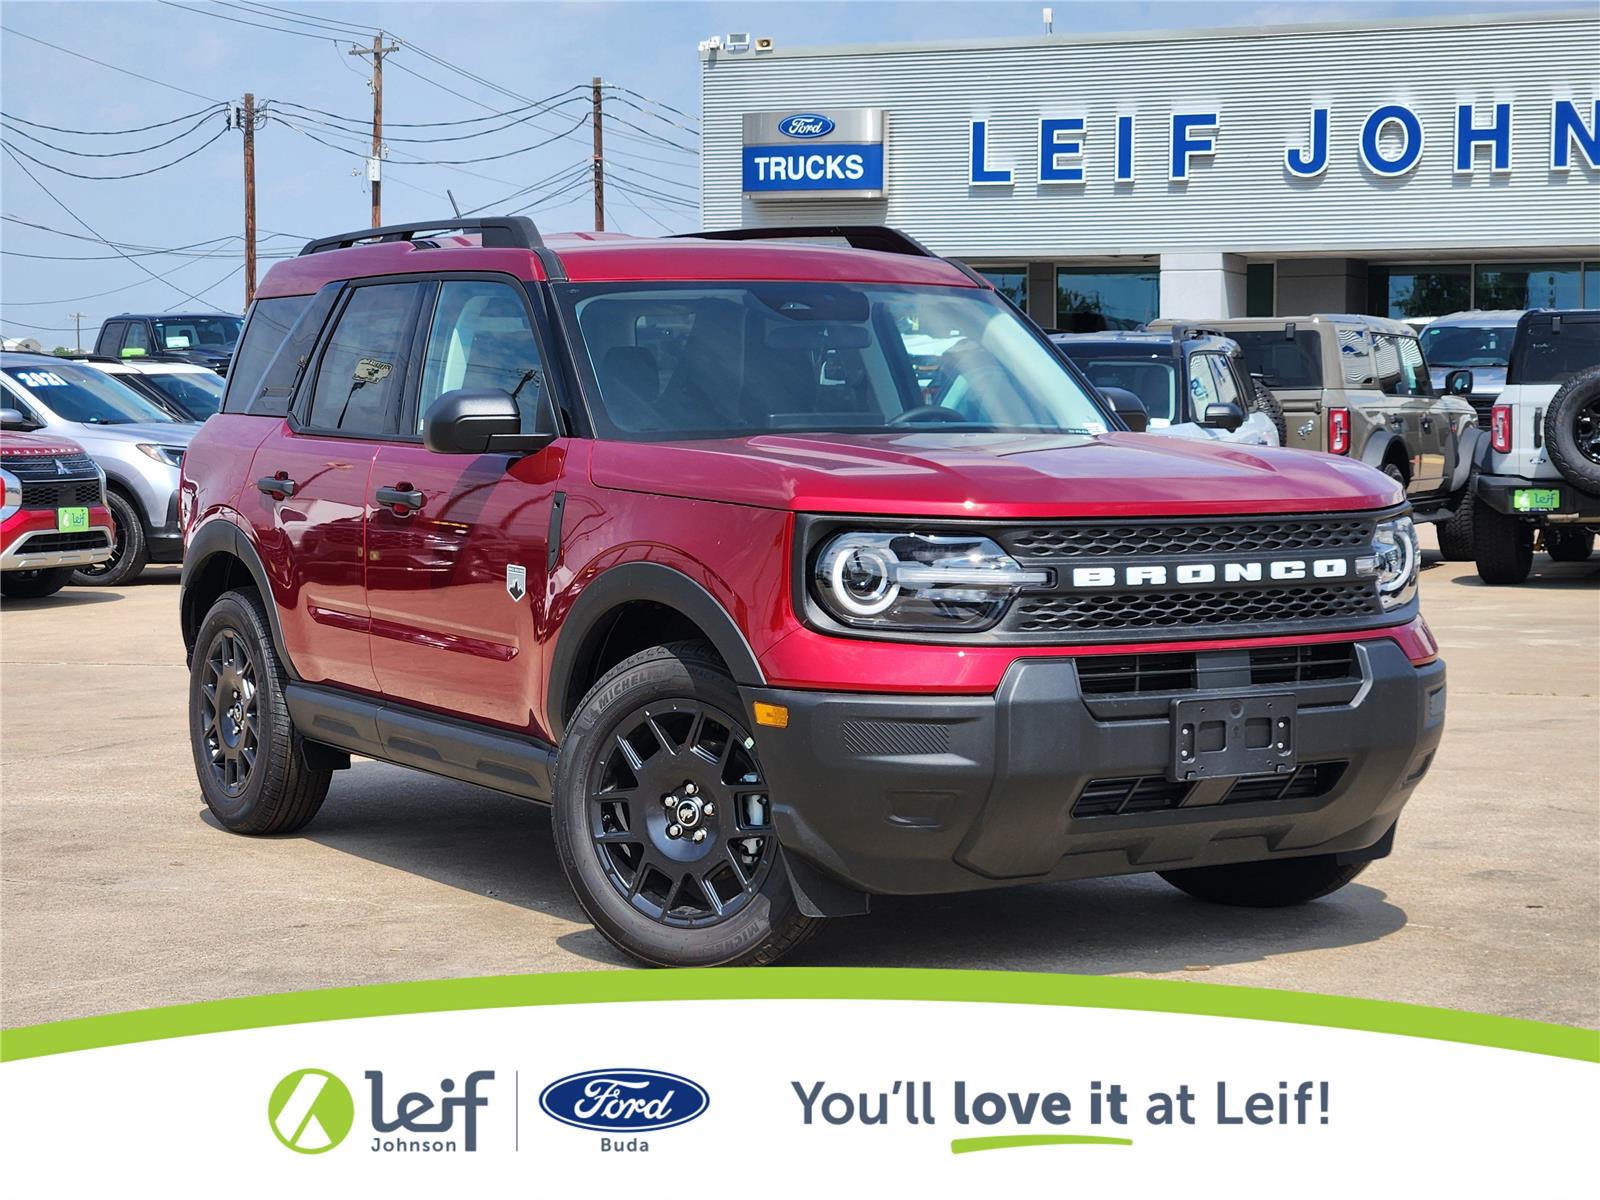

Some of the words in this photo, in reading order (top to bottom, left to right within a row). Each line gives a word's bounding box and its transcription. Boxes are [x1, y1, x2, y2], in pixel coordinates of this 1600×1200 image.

[788, 117, 823, 134] Ford
[969, 111, 1219, 186] LEIF
[1284, 98, 1600, 177] JOHN
[754, 154, 864, 181] TRUCKS
[17, 371, 69, 387] 2021
[1072, 558, 1347, 587] BRONCO
